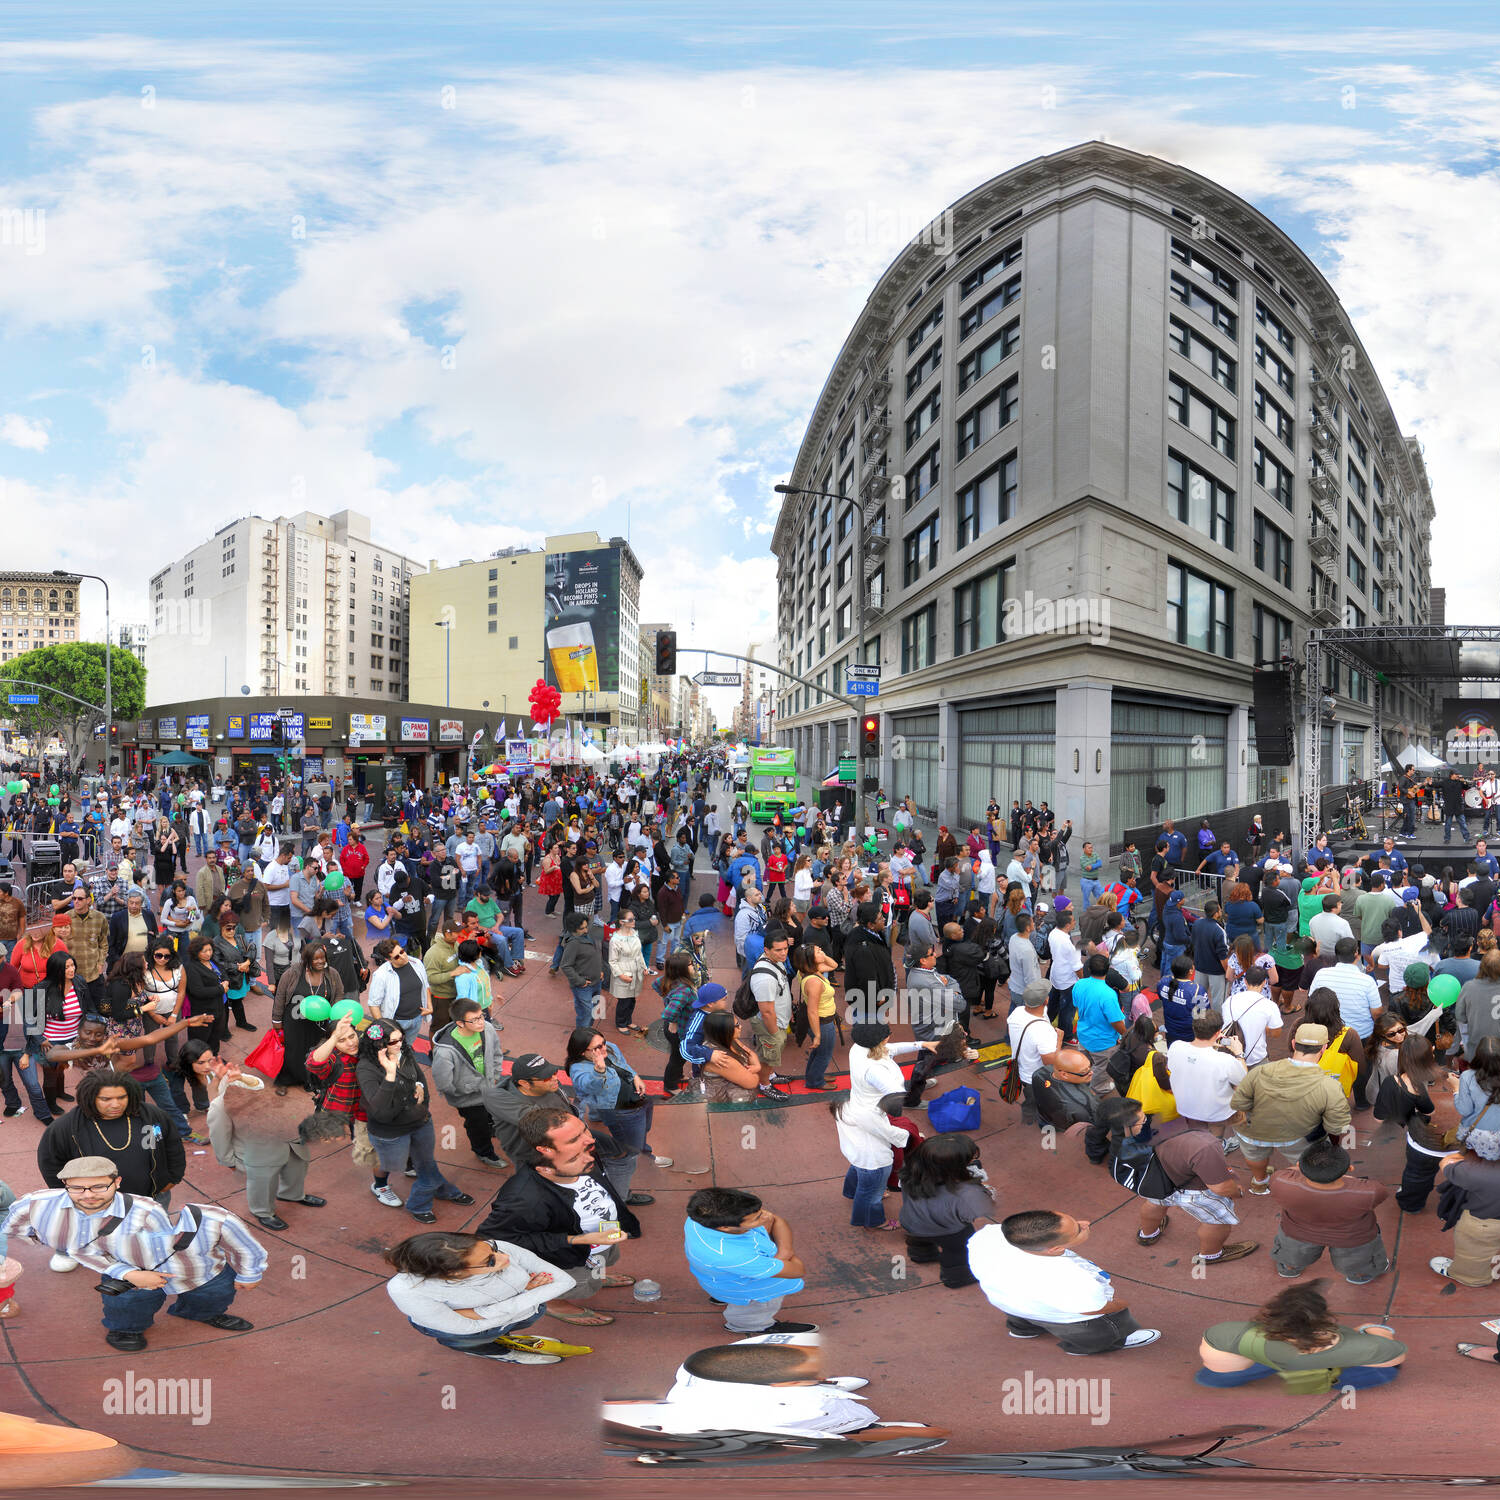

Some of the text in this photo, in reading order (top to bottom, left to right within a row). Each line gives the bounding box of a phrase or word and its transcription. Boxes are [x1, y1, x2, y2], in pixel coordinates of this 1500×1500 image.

[703, 675, 738, 683] ONE WAY
[850, 683, 875, 692] 4th St
[250, 727, 273, 739] PAYDAY
[412, 731, 426, 739] KING
